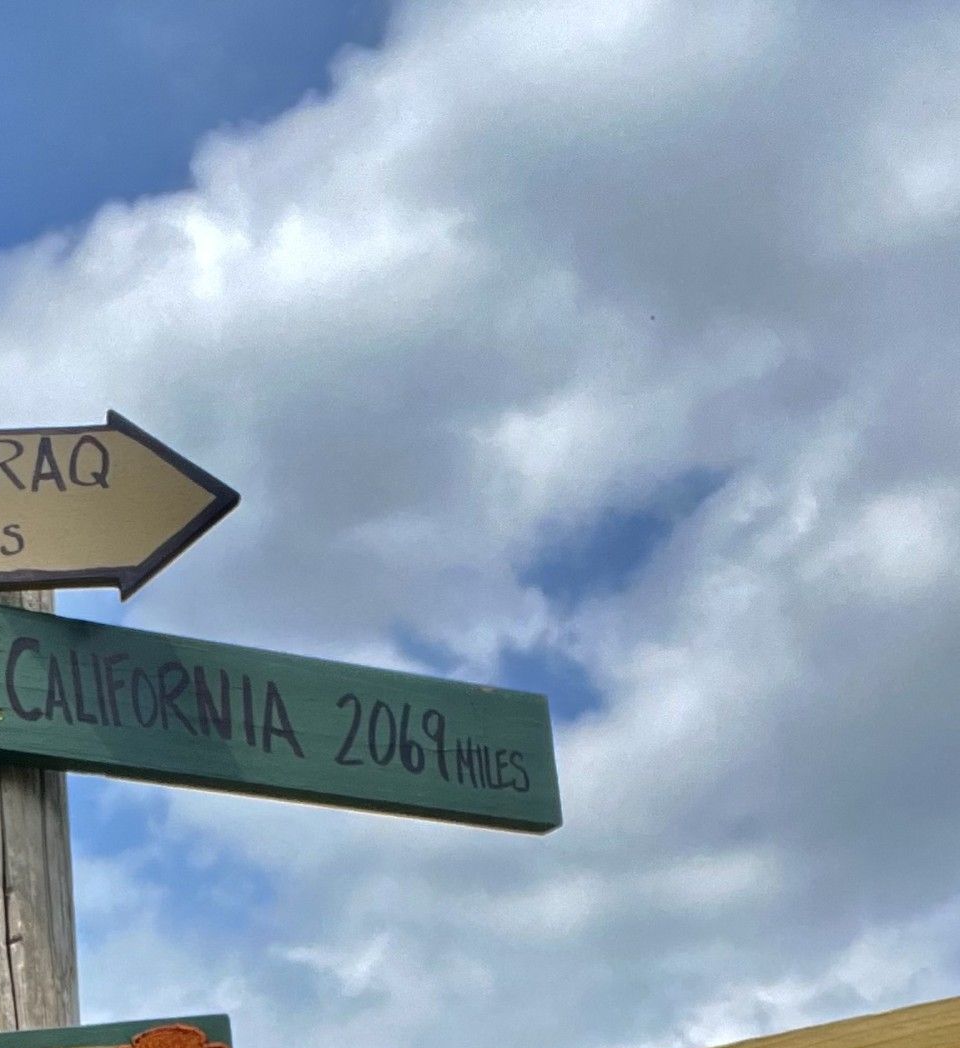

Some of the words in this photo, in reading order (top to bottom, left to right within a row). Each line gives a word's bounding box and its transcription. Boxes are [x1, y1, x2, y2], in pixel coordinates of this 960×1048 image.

[5, 637, 307, 758] CALIFORNIA
[335, 693, 449, 782] 2069
[456, 736, 530, 792] MILES
